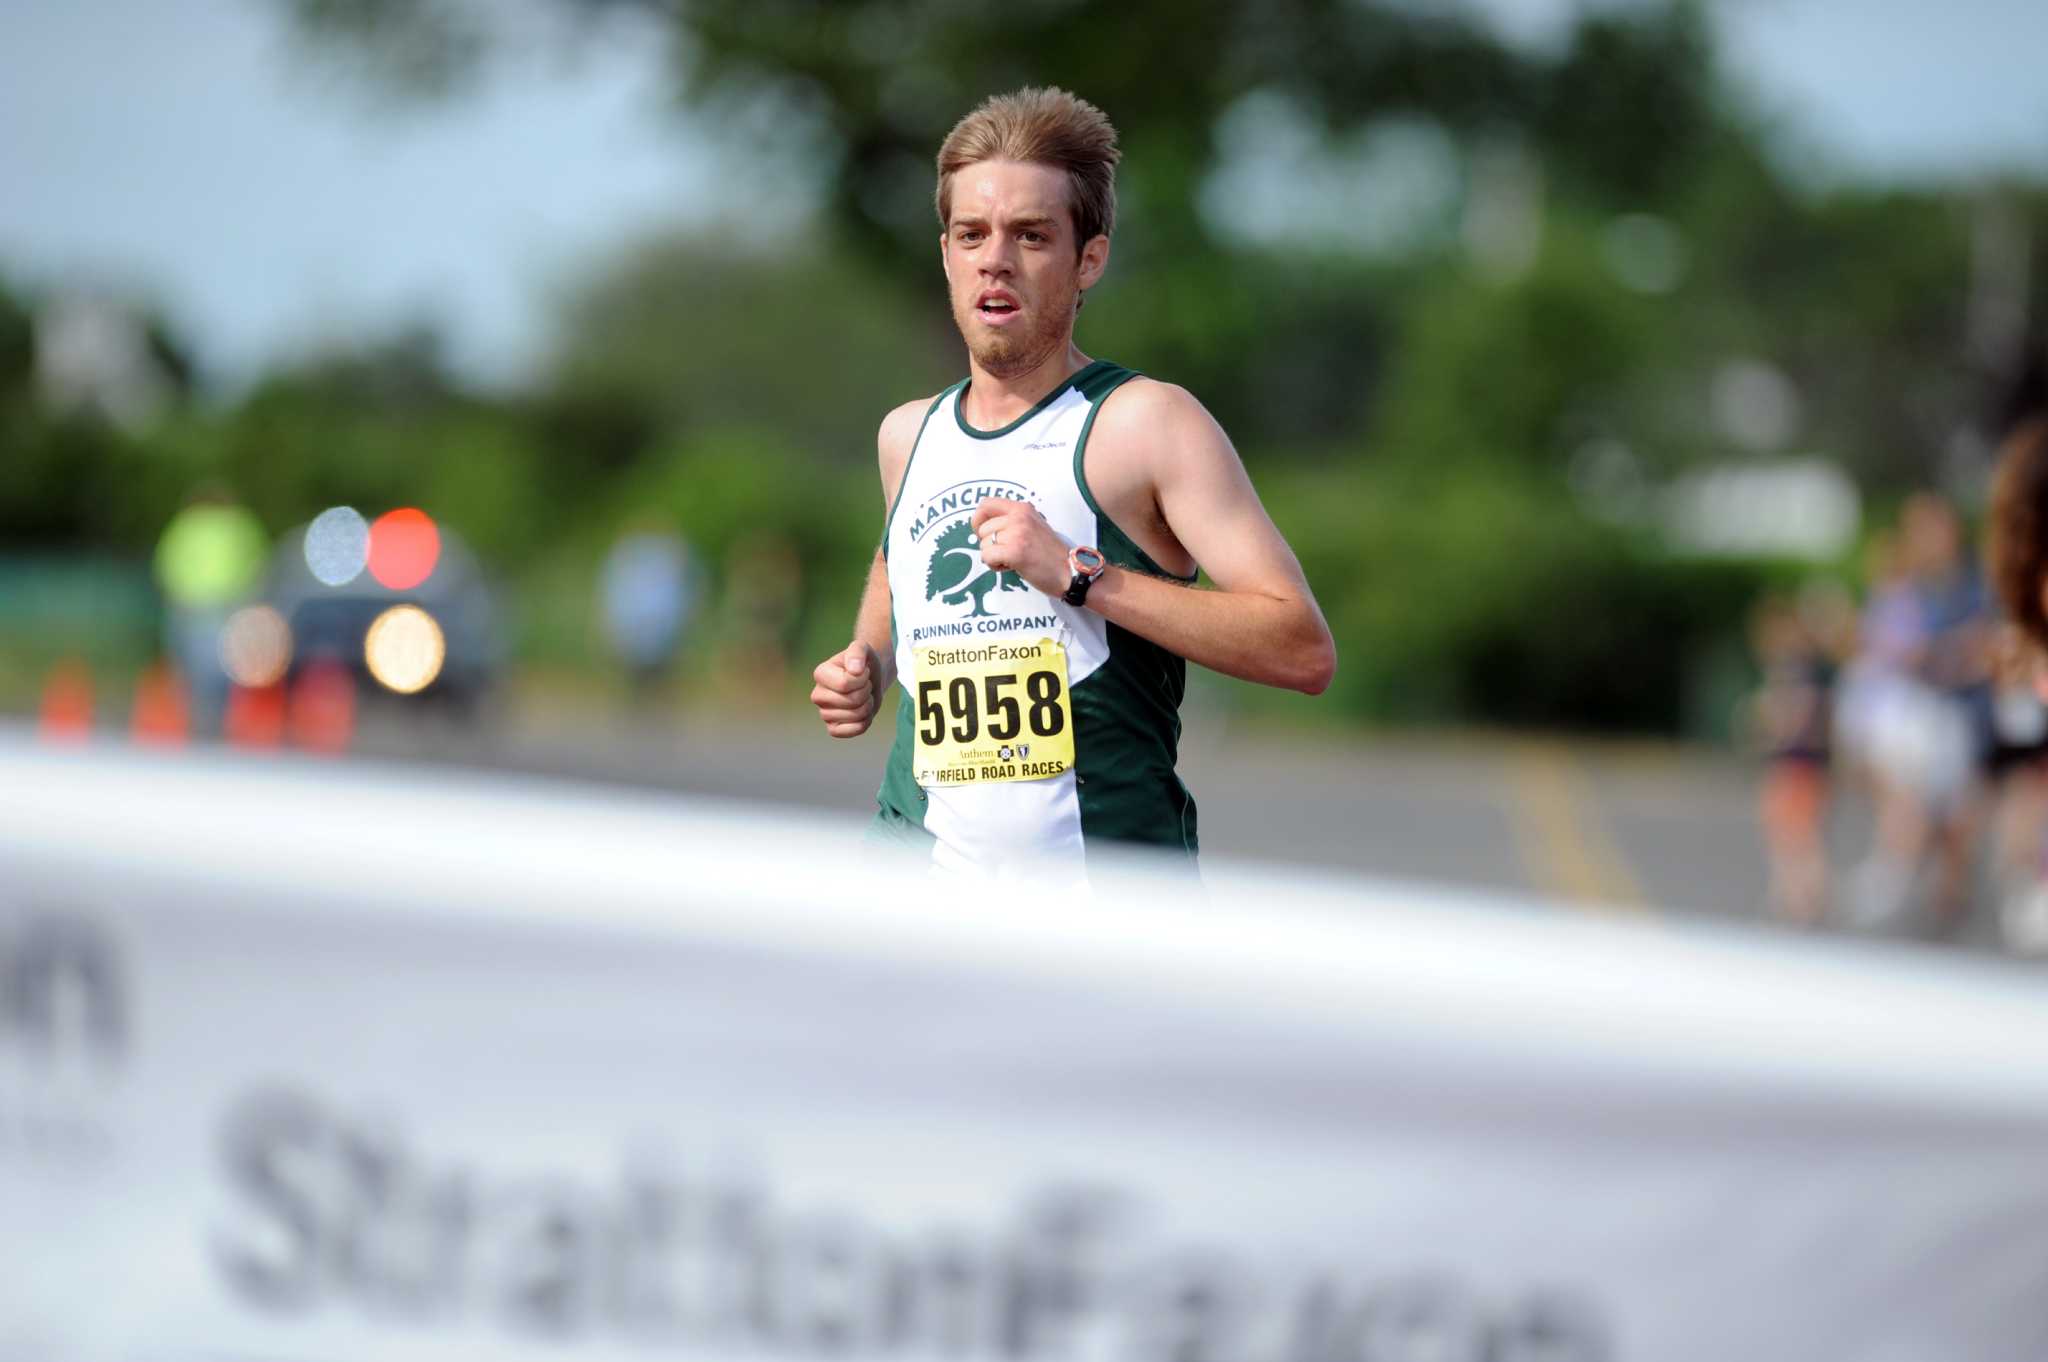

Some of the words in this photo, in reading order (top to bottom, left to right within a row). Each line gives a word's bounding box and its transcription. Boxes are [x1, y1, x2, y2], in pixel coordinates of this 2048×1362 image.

[909, 485, 1040, 542] MANCHEST
[913, 622, 973, 641] RUNNING
[977, 615, 1057, 633] COMPANY
[928, 645, 1042, 666] StrattonFaxon
[918, 670, 1064, 746] 5958
[921, 767, 976, 782] FIRFIELD
[981, 764, 1016, 780] ROAD
[1022, 760, 1064, 776] RACES
